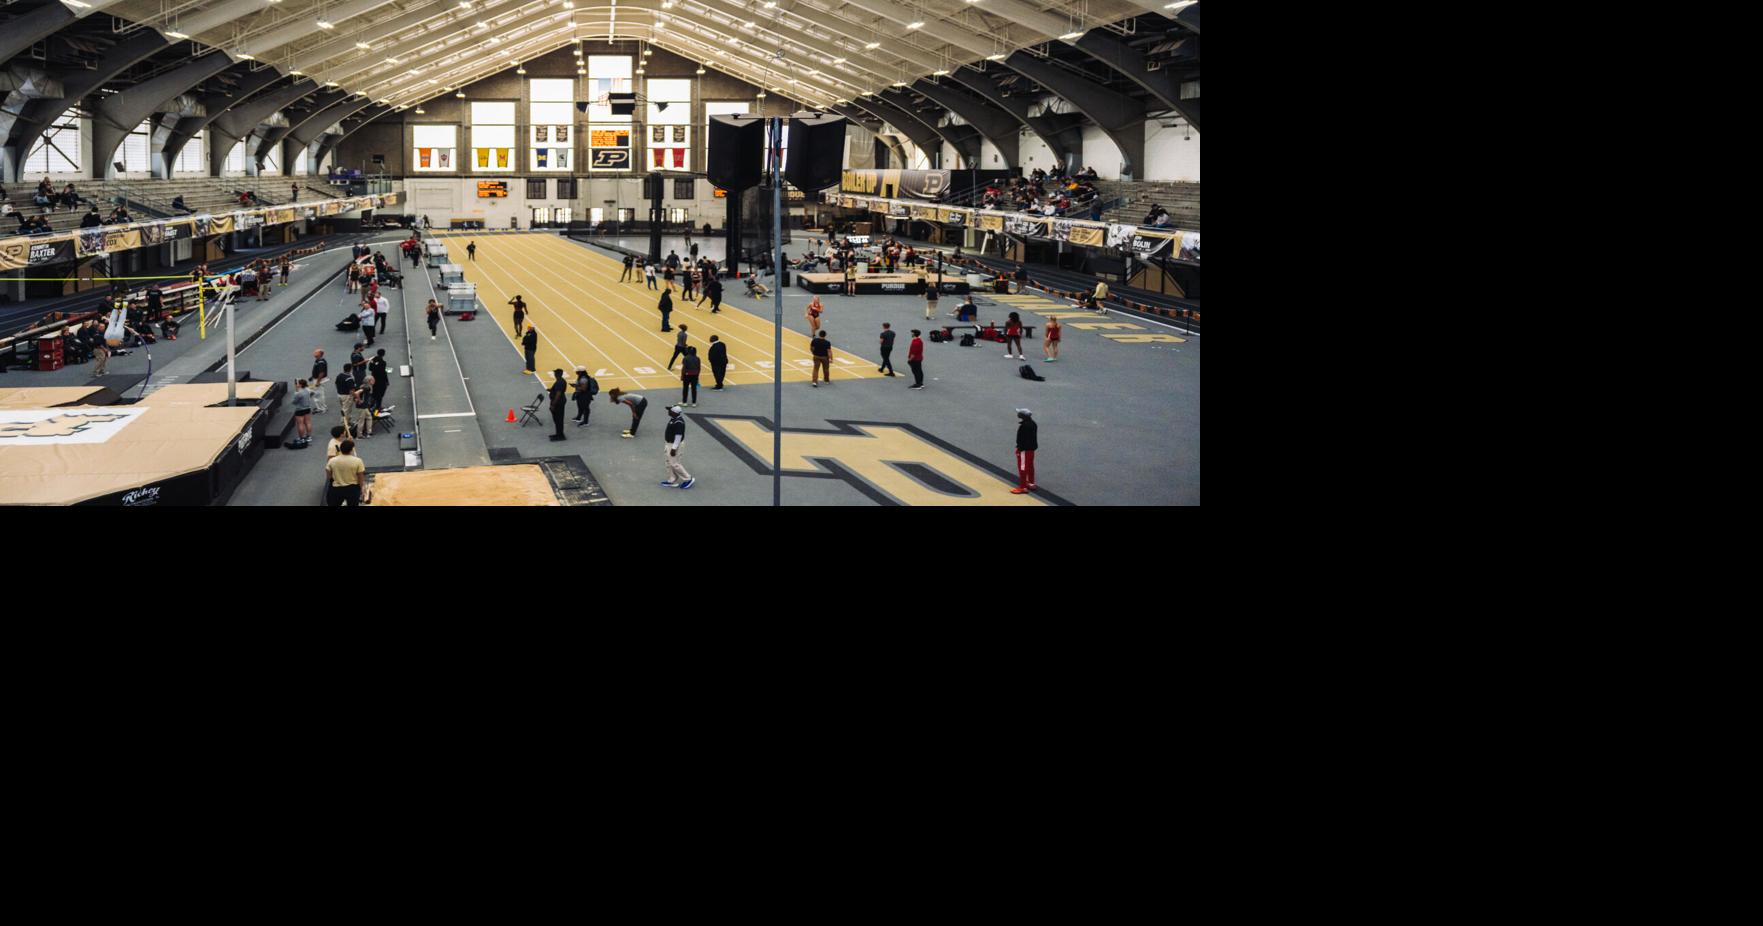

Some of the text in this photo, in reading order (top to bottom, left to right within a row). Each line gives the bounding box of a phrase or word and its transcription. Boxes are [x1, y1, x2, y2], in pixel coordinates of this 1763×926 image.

[842, 171, 877, 193] BOILER UP
[1132, 240, 1152, 249] BOLIN
[30, 248, 56, 259] BAXTER
